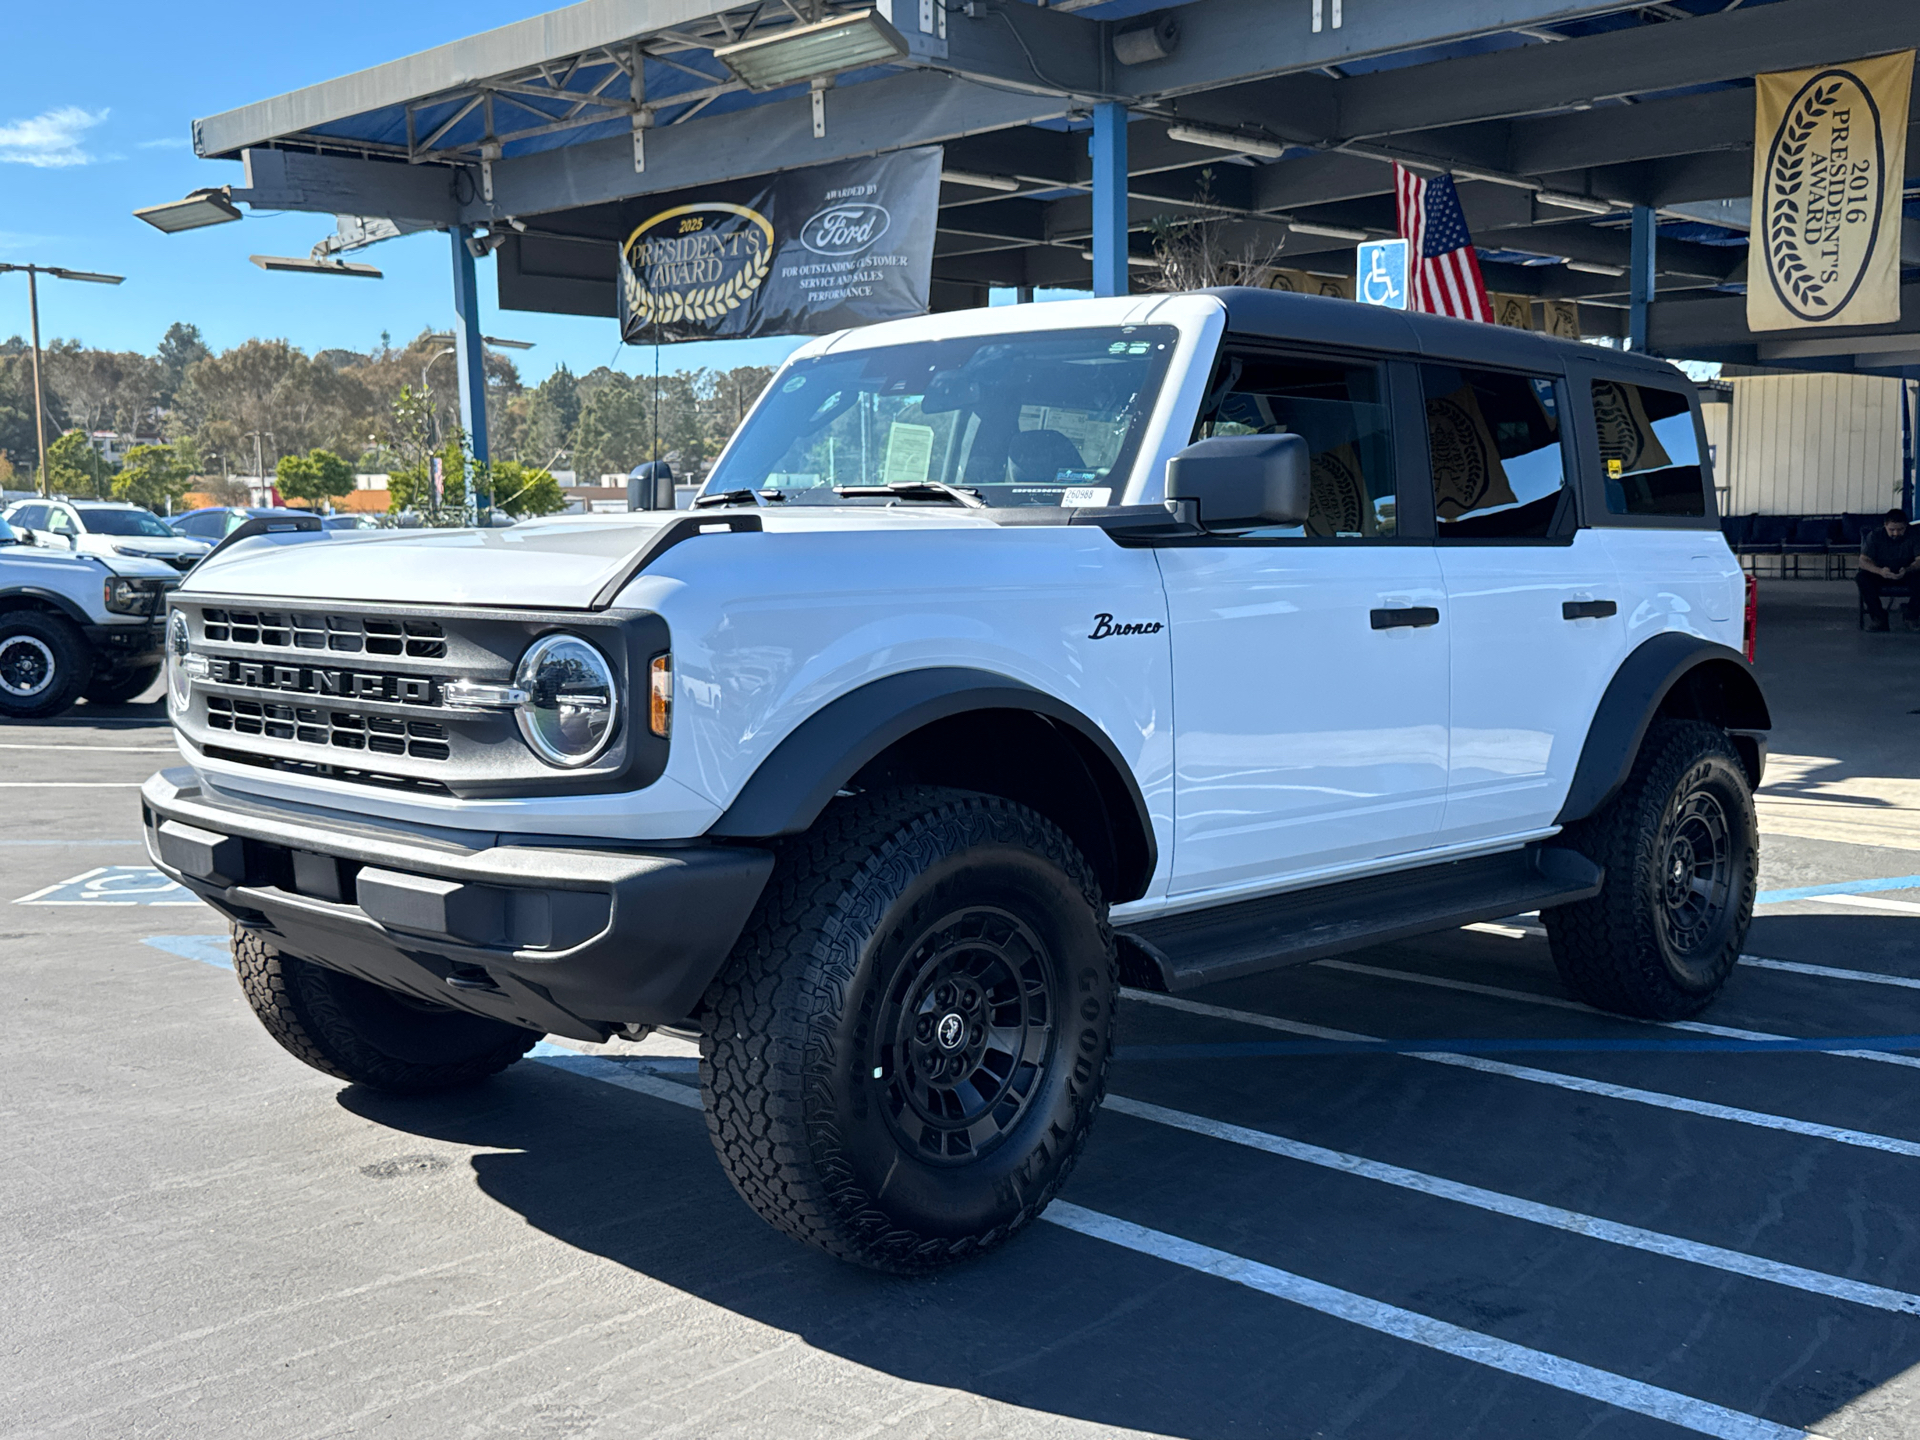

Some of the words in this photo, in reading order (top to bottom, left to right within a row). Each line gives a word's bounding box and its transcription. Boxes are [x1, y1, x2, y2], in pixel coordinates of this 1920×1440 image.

[825, 186, 865, 200] AWARDED
[866, 184, 878, 195] BY
[1803, 151, 1828, 245] AWARD
[1820, 107, 1850, 284] PRESIDENT'S
[1845, 159, 1870, 223] 2016
[679, 217, 704, 233] 2025
[816, 211, 876, 247] Ford
[632, 229, 760, 268] PRESIDENT'S
[651, 257, 722, 288] AWARD
[781, 267, 798, 278] FOR
[799, 261, 855, 275] OUTSTANDING
[856, 255, 908, 267] CUSTOMER
[799, 277, 836, 289] SERVICE
[836, 274, 853, 286] AND
[853, 270, 884, 282] SALES
[808, 286, 873, 302] PERFORMANCE
[1066, 489, 1094, 499] 260988
[1088, 613, 1164, 640] Bronco
[208, 658, 431, 701] BRONCO
[991, 966, 1101, 1203] GOODYEAR
